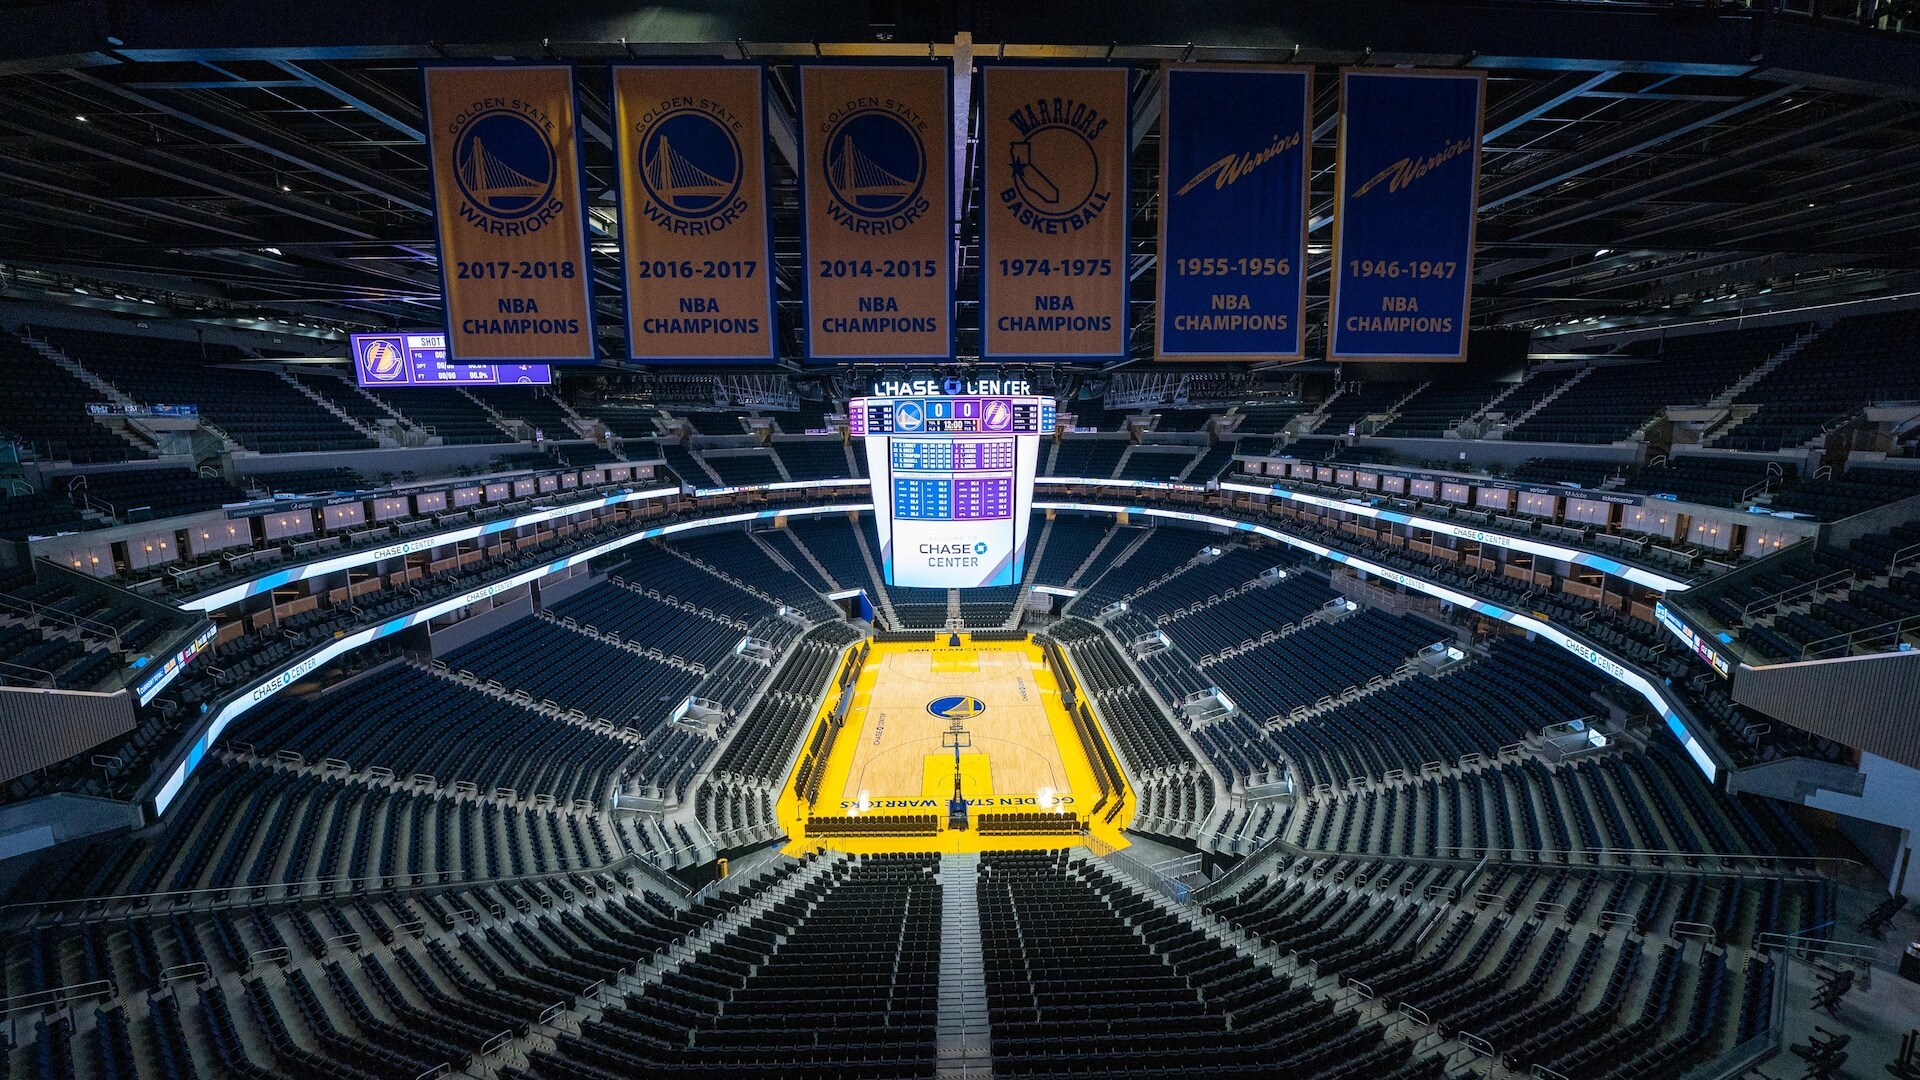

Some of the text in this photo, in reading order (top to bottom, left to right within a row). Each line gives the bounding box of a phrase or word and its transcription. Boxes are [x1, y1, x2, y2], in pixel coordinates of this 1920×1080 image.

[449, 98, 555, 134] GOLDEN STATE
[636, 97, 743, 133] GOLDEN STATE
[821, 97, 928, 133] GOLDEN STATE
[1008, 97, 1109, 141] WARRIORS
[1213, 131, 1300, 191] Warriors
[1389, 137, 1472, 193] Warriors
[459, 197, 564, 236] WARRIORS
[643, 196, 748, 236] WARRIORS
[825, 197, 931, 236] WARRIORS
[999, 187, 1112, 235] BASKETBALL
[457, 260, 575, 279] 2017-2018
[639, 260, 757, 279] 2016-2017
[820, 260, 937, 278] 2014-2015
[999, 259, 1112, 277] 1974-1975
[1176, 258, 1290, 277] 1955-1956
[1349, 260, 1457, 279] 1946-1947
[498, 298, 539, 313] NBA
[679, 298, 720, 312] NBA
[858, 297, 899, 312] NBA
[1035, 296, 1075, 311] NBA
[1211, 294, 1251, 310] NBA
[1382, 296, 1419, 312] NBA
[462, 318, 579, 335] CHAMPIONS
[643, 318, 759, 334] CHAMPIONS
[822, 318, 937, 333] CHAMPIONS
[998, 316, 1112, 332] CHAMPIONS
[1174, 314, 1288, 331] CHAMPIONS
[1346, 316, 1453, 333] CHAMPIONS
[420, 337, 441, 348] SHOT
[875, 380, 1031, 397] CHASE CENTER
[935, 403, 943, 417] 0
[964, 403, 972, 417] 0
[943, 420, 963, 429] 12:00
[1602, 496, 1634, 505] ticketmaster
[1453, 527, 1511, 547] CHASE CENTER
[373, 539, 435, 560] CHASE CENTER
[919, 543, 971, 554] CHASE
[928, 557, 979, 567] CENTER
[1381, 569, 1425, 590] CHASE CENTER
[466, 581, 514, 603] CHASE CENTER
[1565, 639, 1624, 679] CHASE CENTER
[253, 657, 317, 701] CHASE CENTER
[946, 798, 994, 806] STAE
